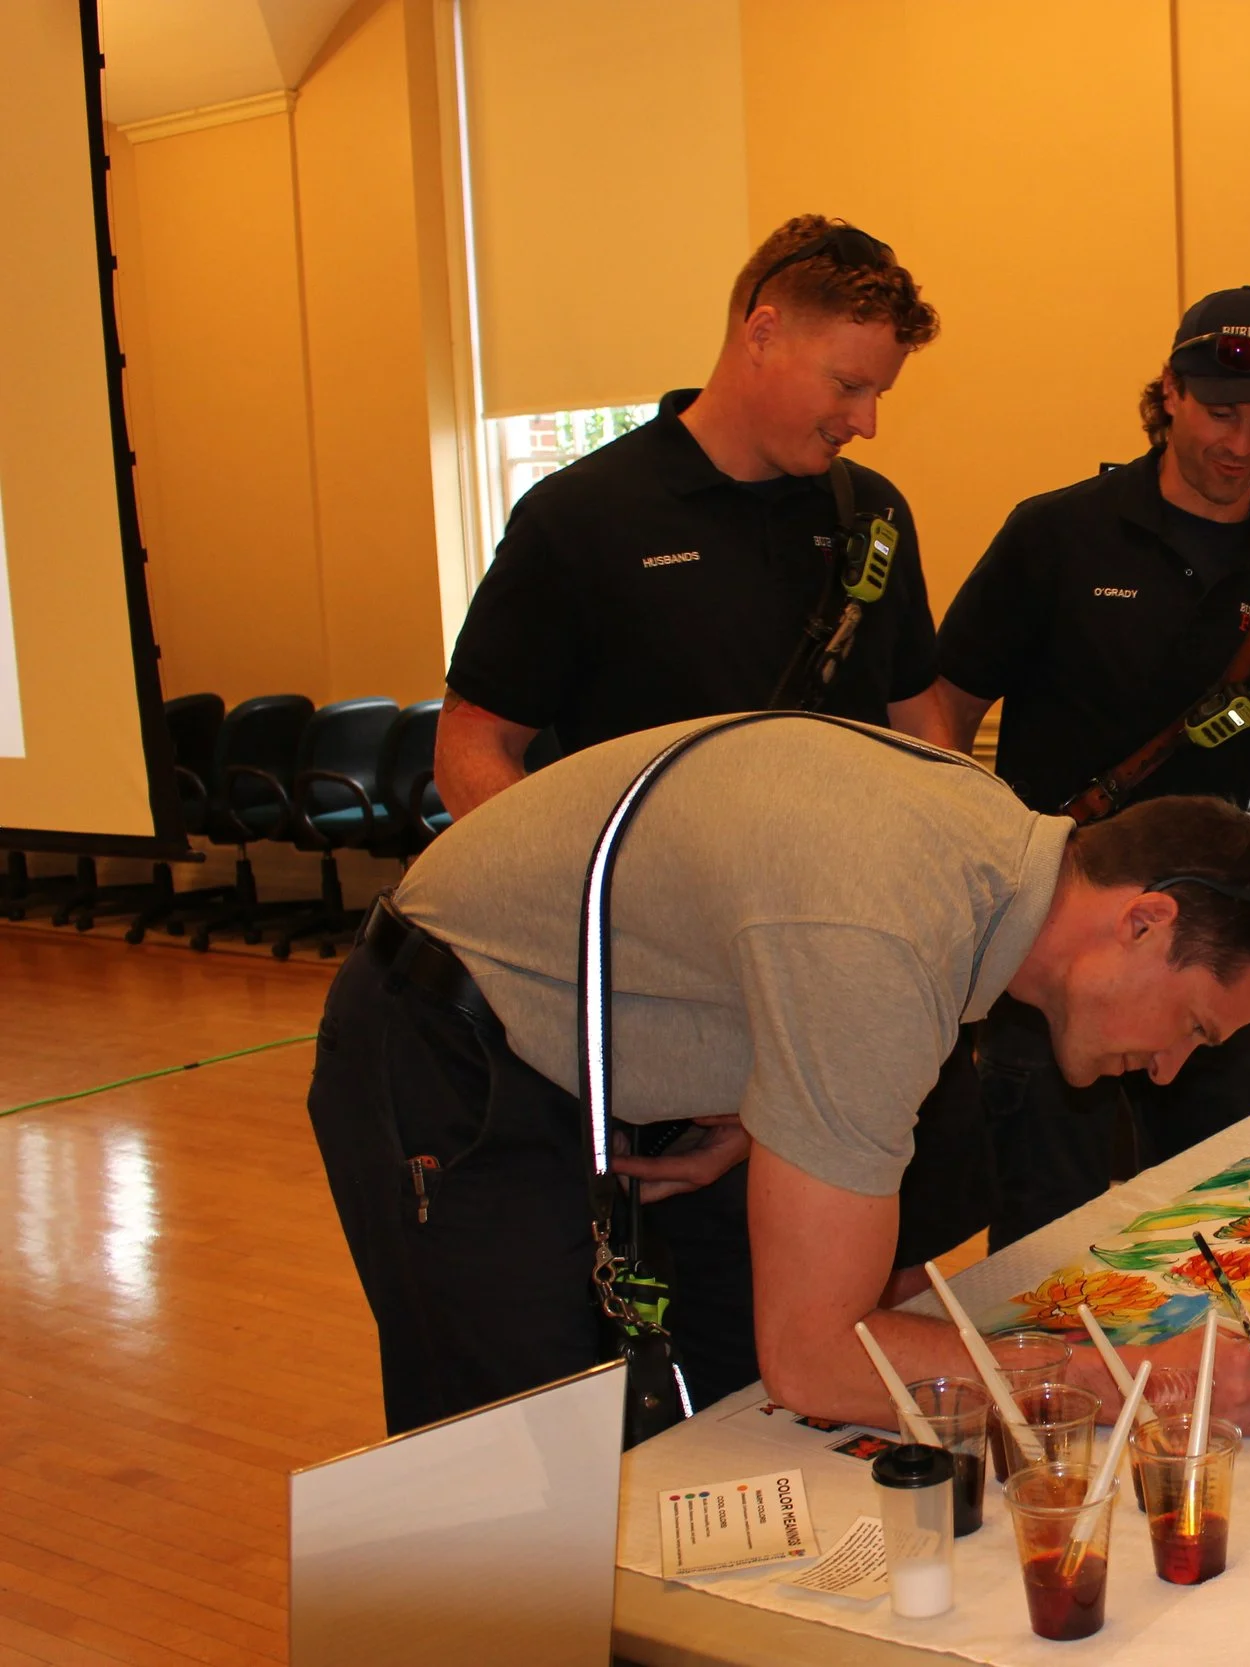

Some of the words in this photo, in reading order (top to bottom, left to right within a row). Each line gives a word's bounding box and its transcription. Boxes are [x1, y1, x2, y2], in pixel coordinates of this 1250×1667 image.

[642, 551, 700, 568] HUSBANDS
[1094, 588, 1138, 600] O'GRADY
[776, 1477, 794, 1511] COLOR
[717, 1495, 726, 1511] COOL
[783, 1510, 802, 1547] MEANINGS
